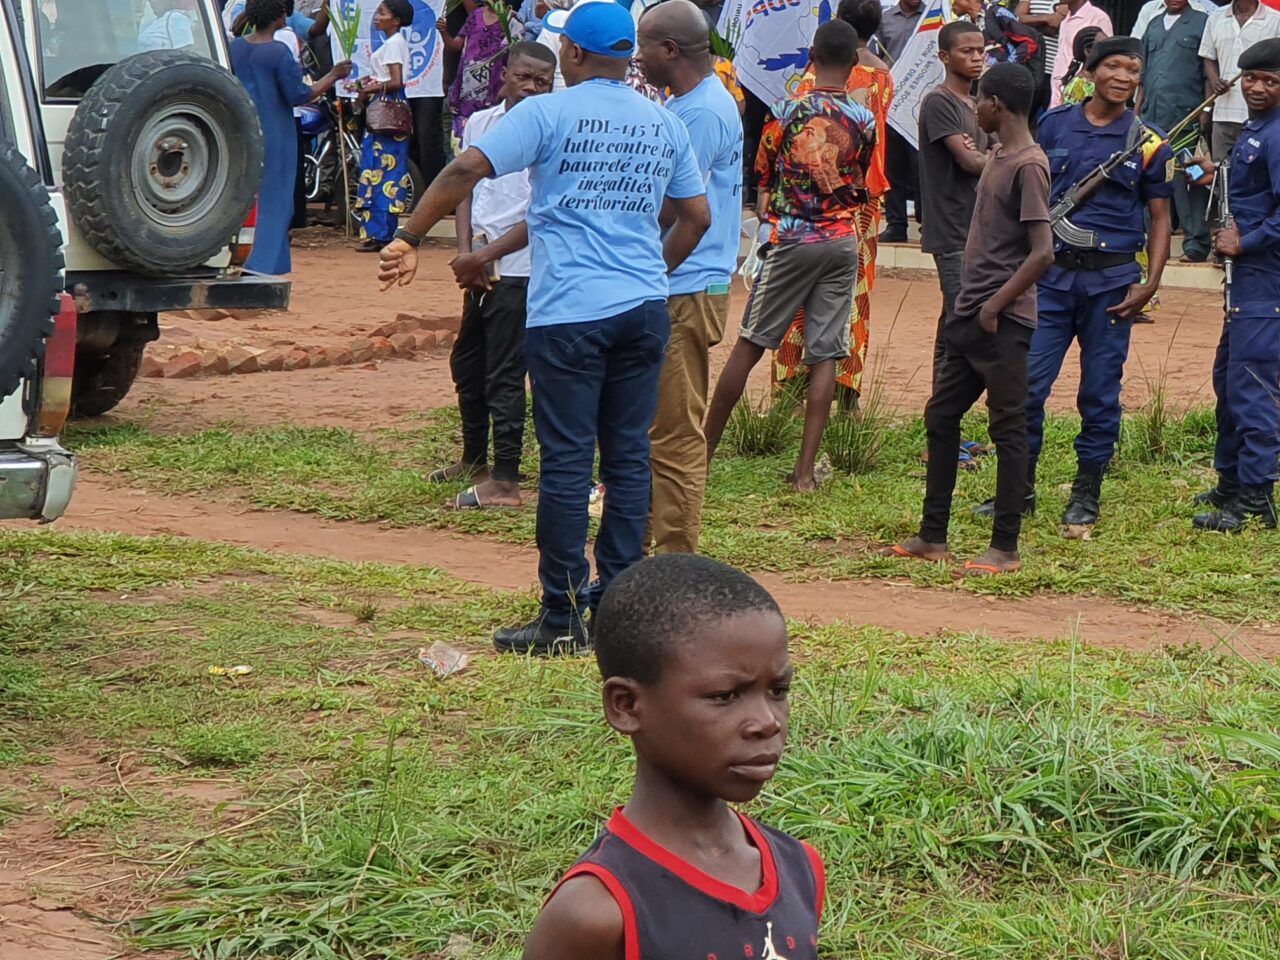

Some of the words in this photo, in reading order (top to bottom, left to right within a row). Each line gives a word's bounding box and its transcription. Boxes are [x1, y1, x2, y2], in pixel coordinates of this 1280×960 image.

[576, 119, 646, 137] PDL-145
[563, 138, 604, 153] lutte
[606, 140, 659, 156] contre
[661, 144, 675, 159] la
[634, 161, 652, 174] et
[652, 161, 670, 178] les
[577, 174, 653, 194] inégalités
